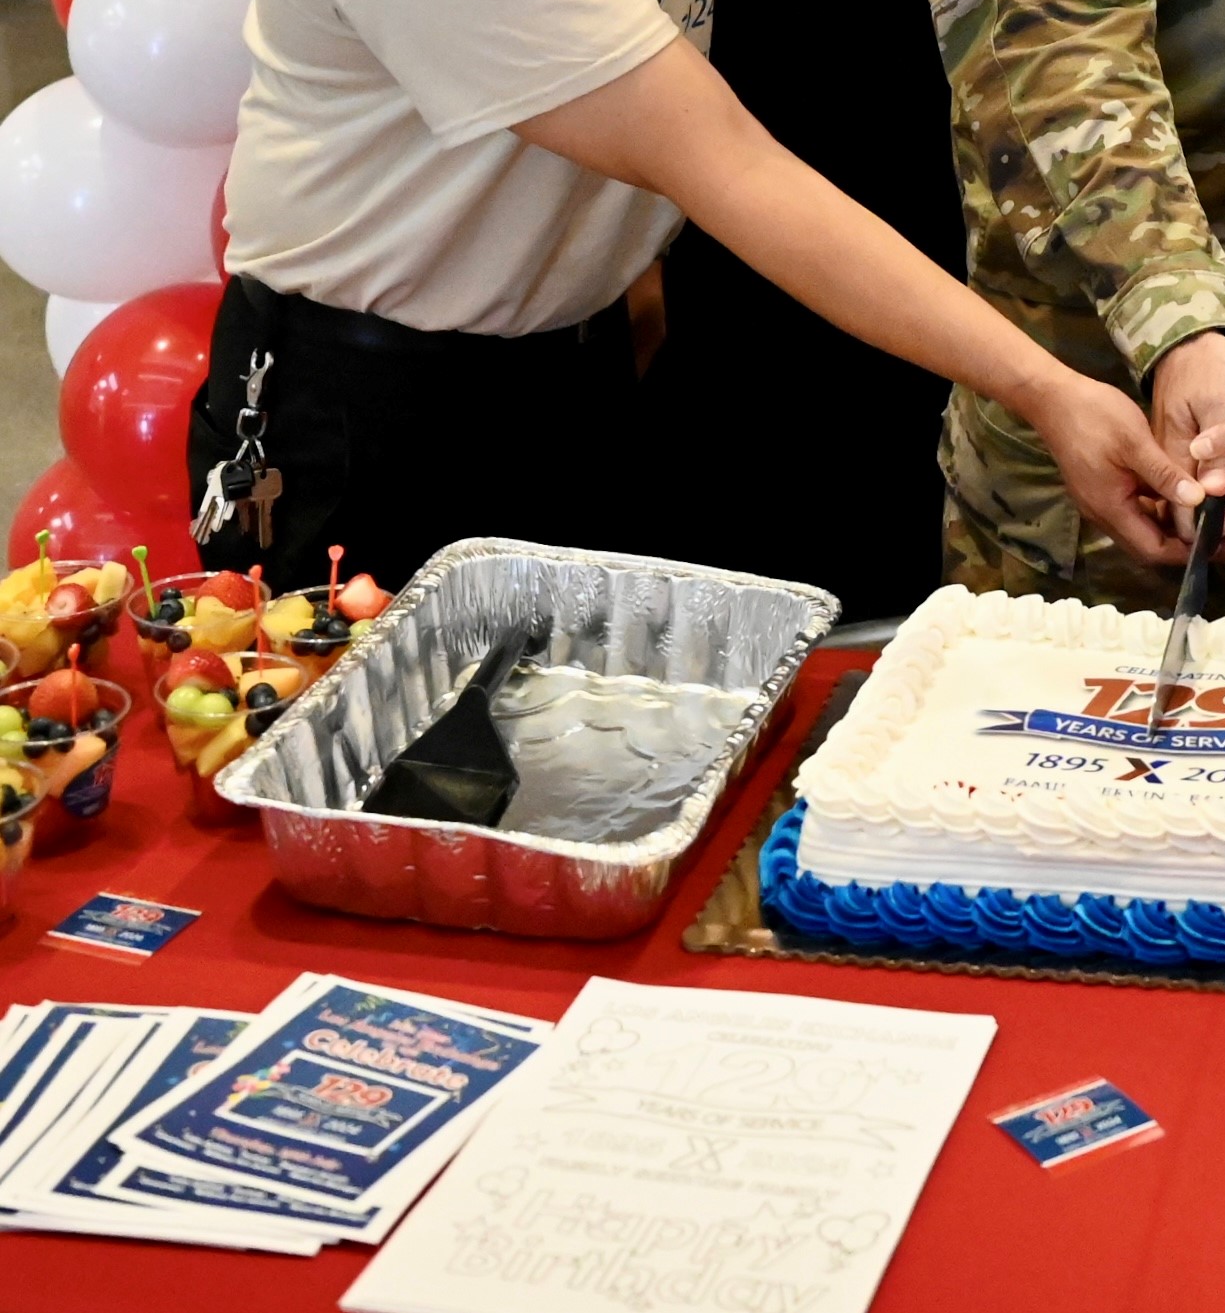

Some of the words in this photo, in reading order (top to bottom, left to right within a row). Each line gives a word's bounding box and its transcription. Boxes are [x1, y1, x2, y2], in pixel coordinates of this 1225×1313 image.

[1055, 716, 1128, 742] YEARS
[1131, 730, 1168, 748] OF
[1025, 751, 1109, 773] 1895
[303, 1028, 470, 1090] Celebrate
